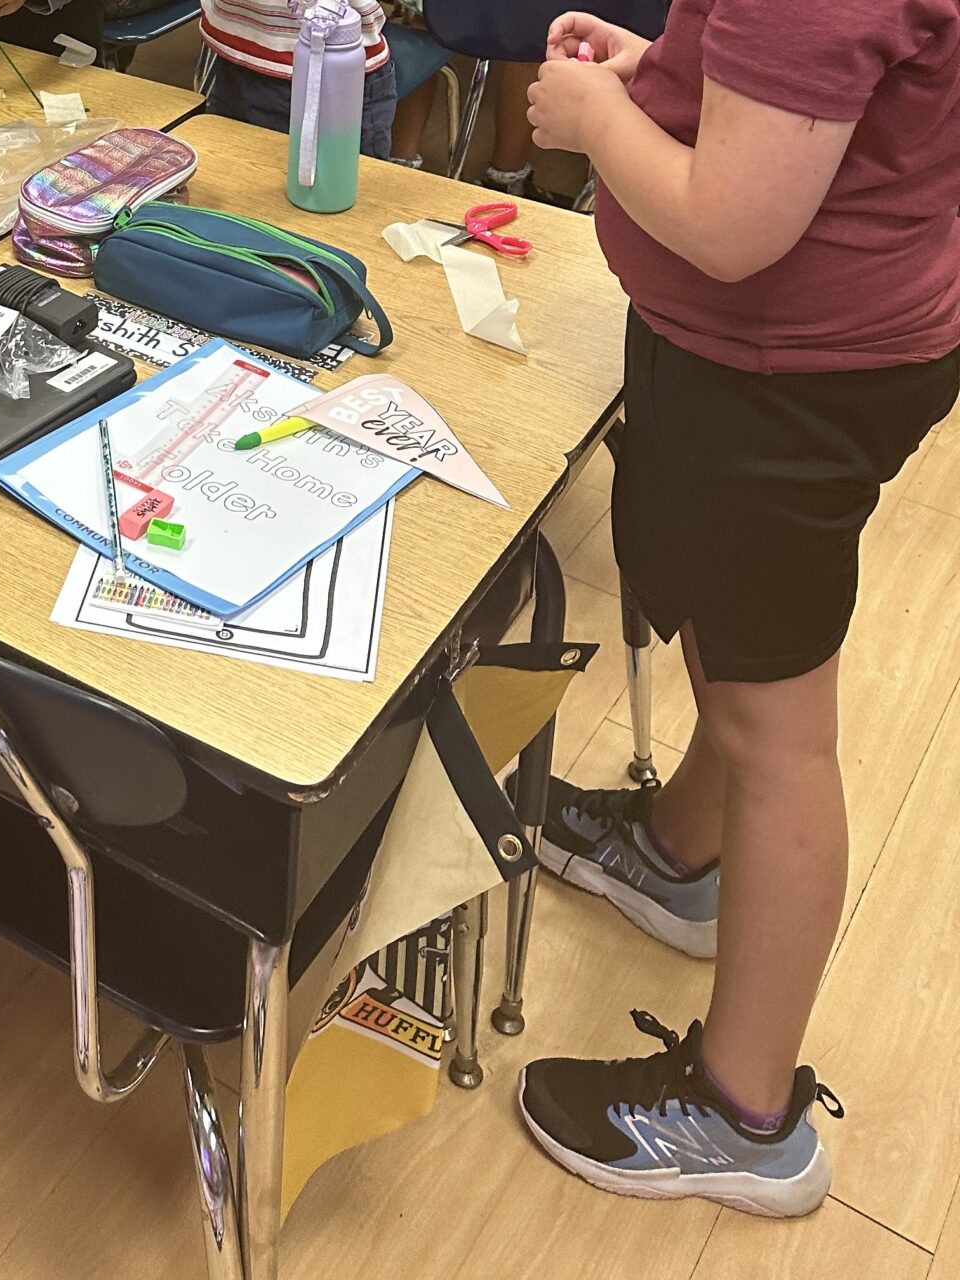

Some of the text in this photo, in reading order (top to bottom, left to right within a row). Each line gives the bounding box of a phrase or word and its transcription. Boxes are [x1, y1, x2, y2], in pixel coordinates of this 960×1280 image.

[171, 342, 196, 358] S
[328, 386, 405, 426] BEST
[378, 401, 458, 462] YEAR
[156, 399, 358, 510] Take Home
[361, 419, 441, 463] ever!
[54, 506, 161, 575] COMMUNATOR
